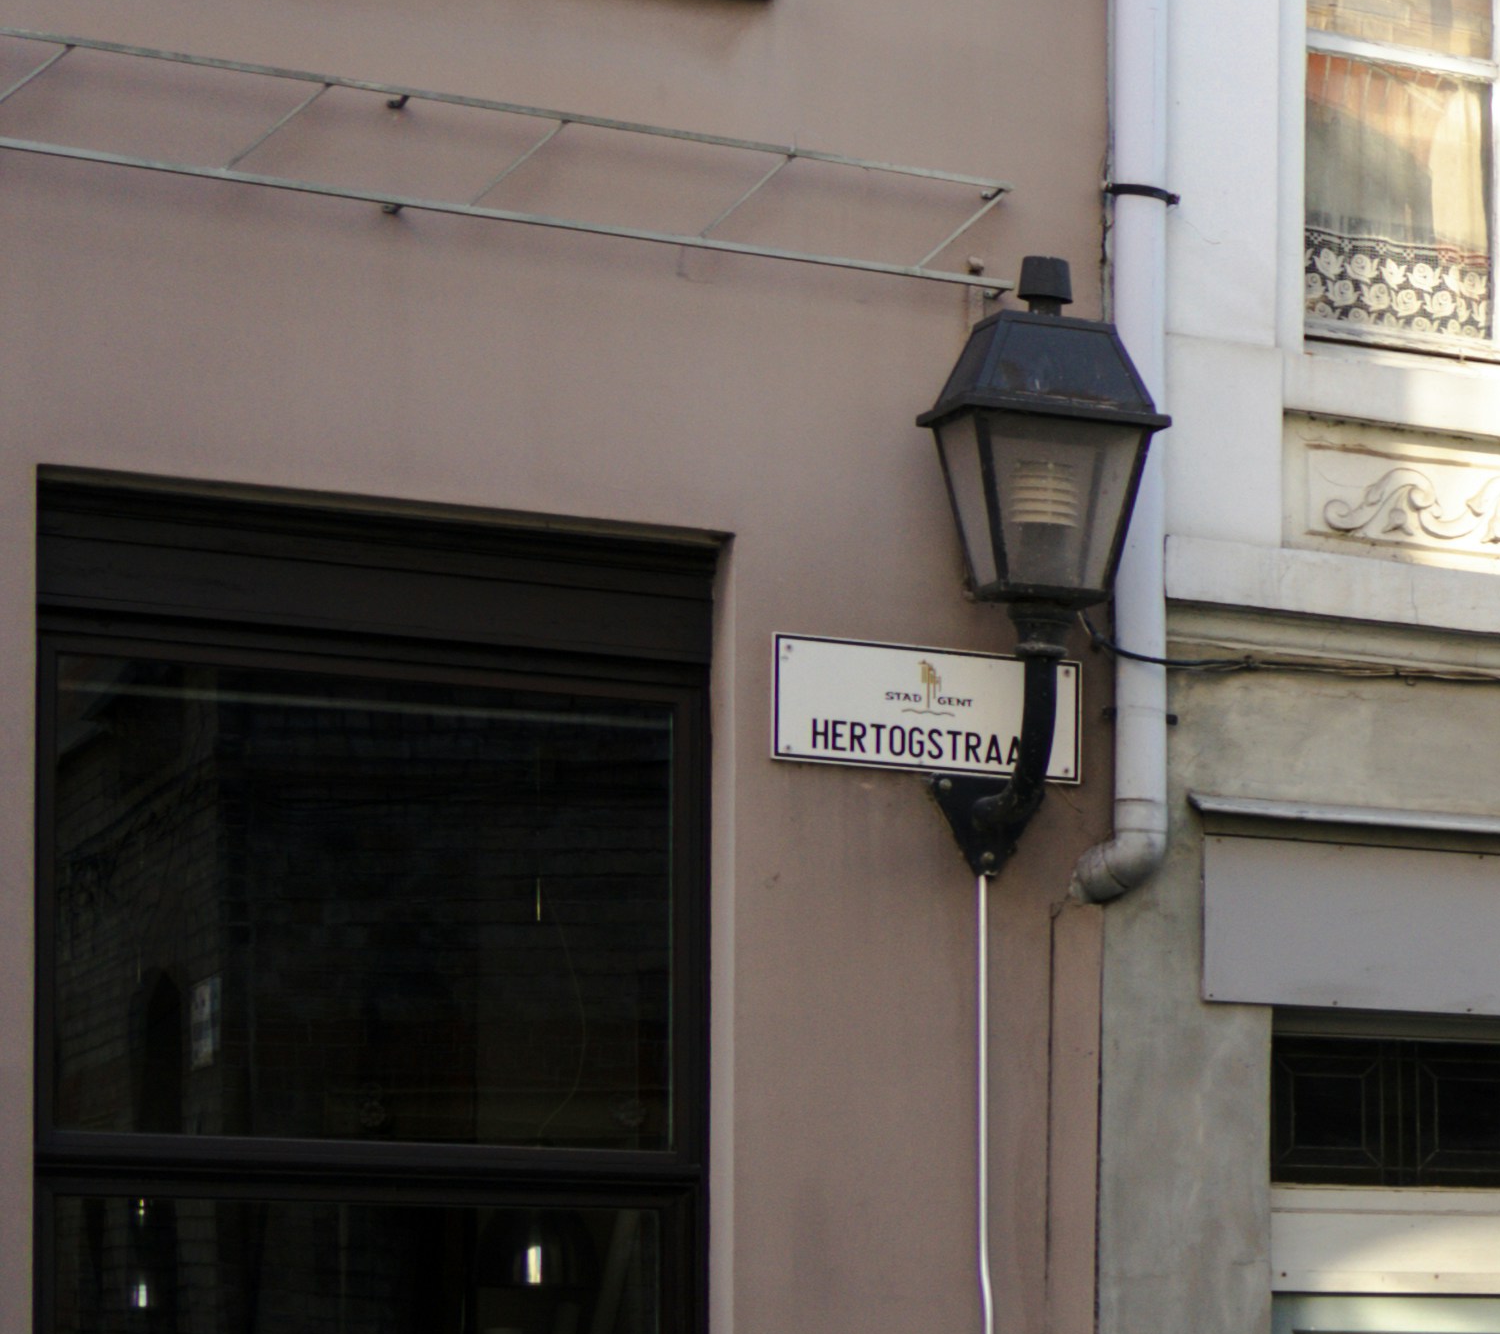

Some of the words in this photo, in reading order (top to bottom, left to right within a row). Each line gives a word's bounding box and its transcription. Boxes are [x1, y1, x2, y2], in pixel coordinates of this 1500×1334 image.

[884, 690, 923, 704] STAD
[936, 695, 974, 708] GENT
[811, 718, 1021, 765] HERTOGSTRAA
